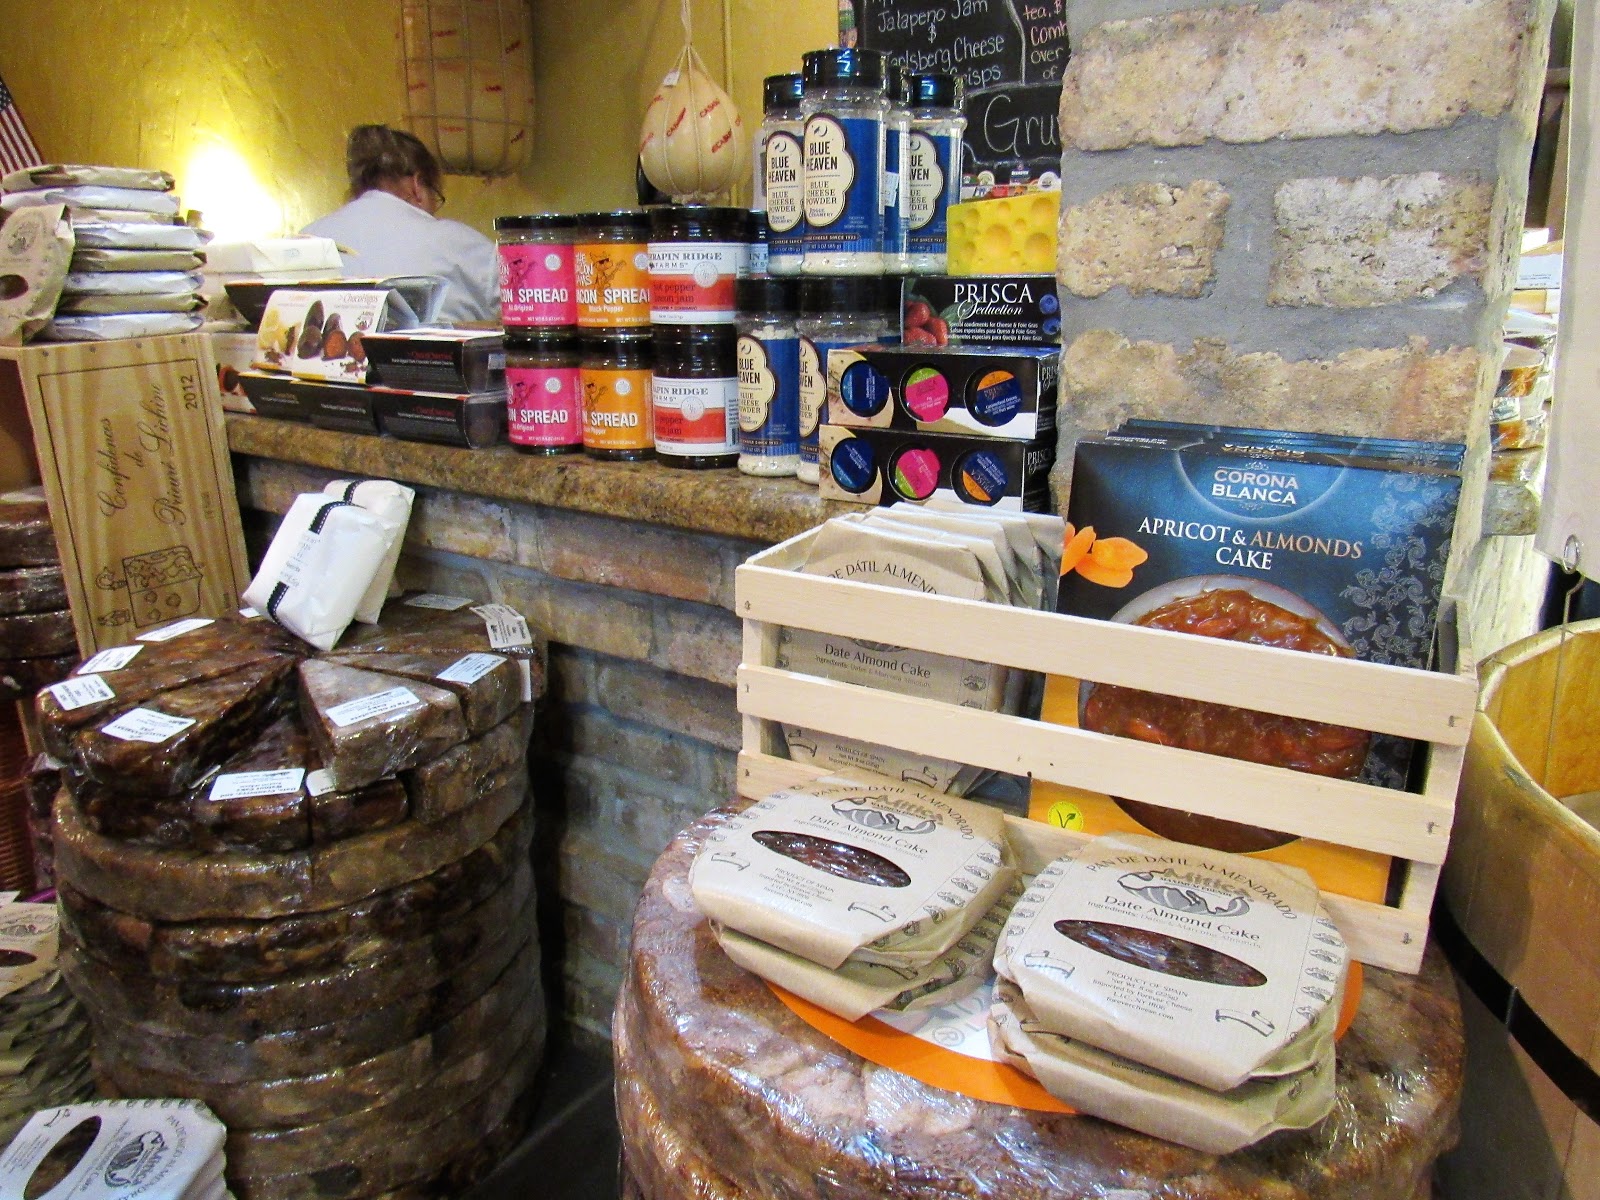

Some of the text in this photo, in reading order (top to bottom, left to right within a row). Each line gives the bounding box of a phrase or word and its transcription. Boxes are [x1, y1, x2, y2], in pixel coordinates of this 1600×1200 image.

[951, 0, 988, 19] Jam
[954, 35, 1004, 62] Cheese
[809, 141, 831, 156] BLUE
[771, 156, 790, 169] BLUE
[806, 156, 838, 172] HEAVEN
[810, 181, 829, 189] BLUE
[771, 191, 789, 199] BLUE
[682, 252, 722, 260] RIDGE
[518, 287, 569, 304] SPREAD
[664, 283, 696, 293] pepper
[954, 283, 1034, 304] PRISCA
[602, 304, 624, 313] Pepper
[957, 296, 1024, 323] Seduction
[180, 374, 198, 411] 2012
[671, 387, 709, 396] RIDGE
[520, 409, 569, 424] SPREAD
[591, 412, 638, 428] SPREAD
[97, 417, 131, 517] Confidences
[1214, 469, 1300, 490] CORONA
[1211, 483, 1297, 505] BLANCA
[1137, 516, 1363, 560] APRICOT & ALMONDS
[845, 559, 880, 576] DÁTIL
[1215, 547, 1273, 571] CAKE
[825, 643, 931, 679] Date Almond Cake
[810, 814, 928, 855] Date Almond Cake
[1086, 858, 1116, 873] PAN
[1116, 855, 1141, 866] DE
[1200, 861, 1298, 921] ALMENDRADO
[1104, 895, 1261, 942] Date Almond Cake
[1092, 979, 1125, 992] Imported
[1106, 970, 1147, 986] PRODUCT
[1163, 986, 1189, 998] SPAIN
